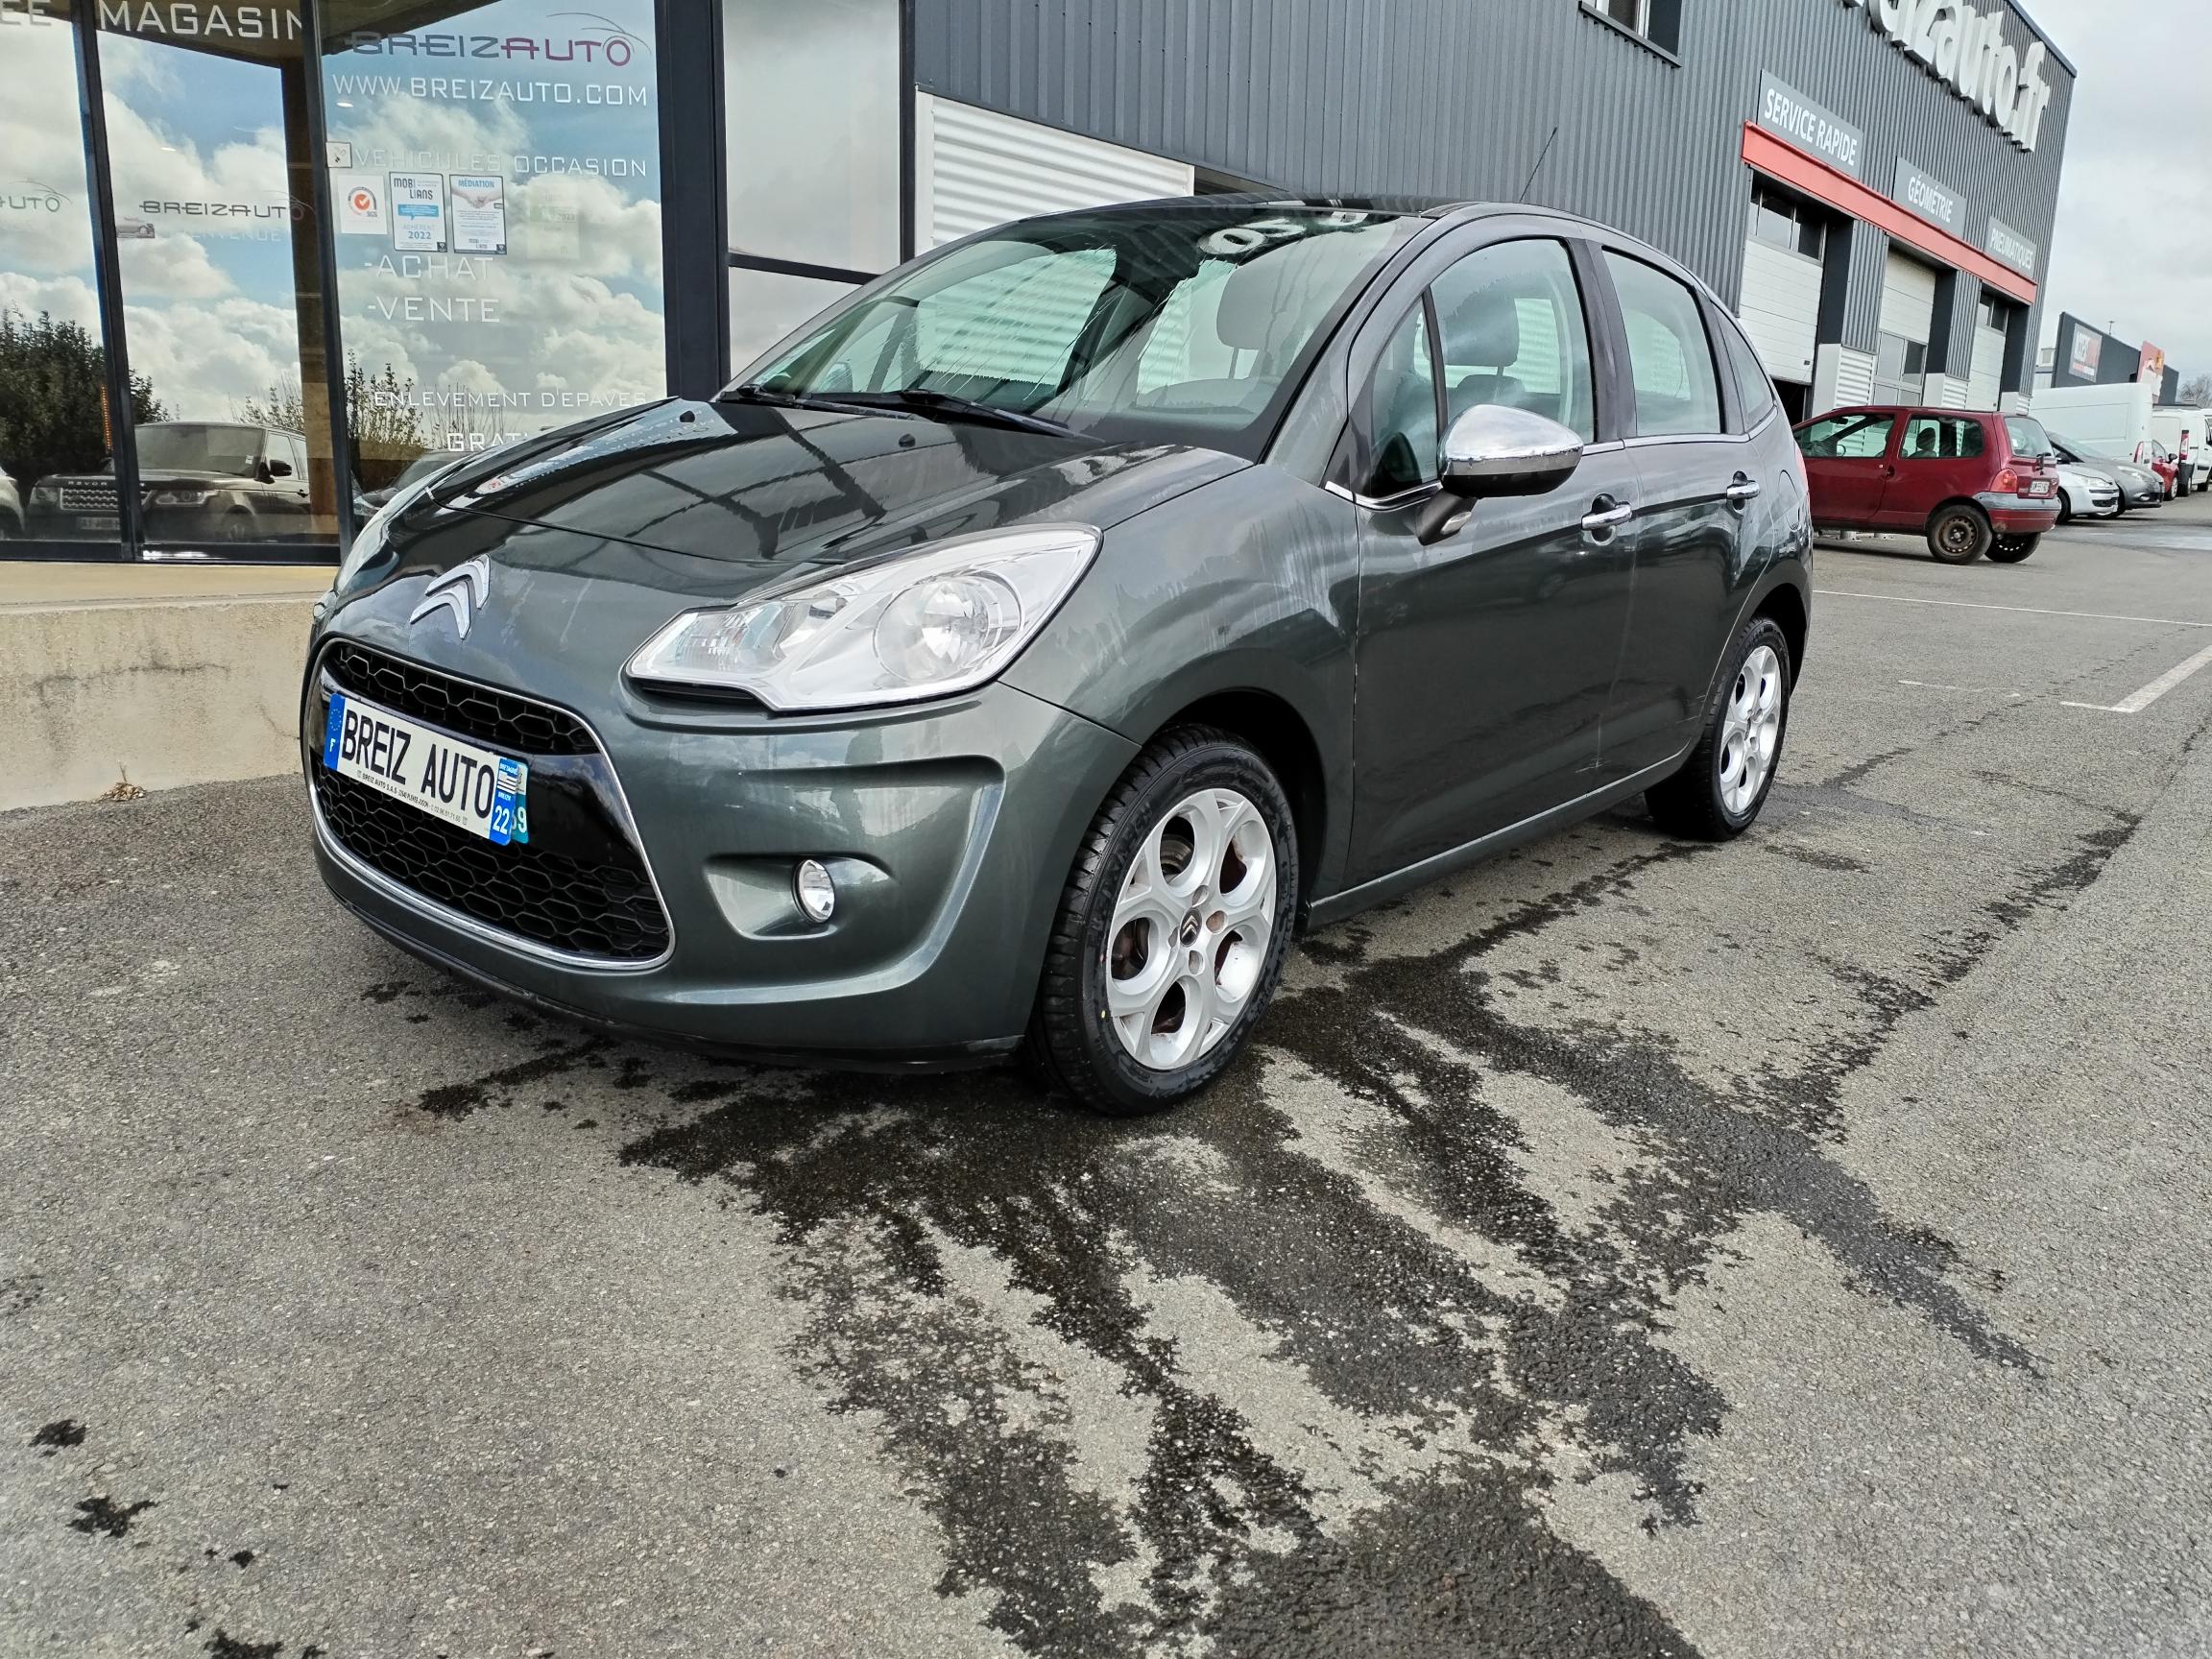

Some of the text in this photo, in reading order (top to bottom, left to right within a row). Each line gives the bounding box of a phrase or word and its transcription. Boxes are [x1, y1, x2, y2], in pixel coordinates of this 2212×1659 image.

[345, 30, 632, 67] BREIZAUTO
[332, 74, 648, 107] WWW.BREIZAUTO.COM
[1764, 87, 1859, 166] SERVICE RAPIDE
[354, 148, 647, 177] VEHICULES OCCASION
[139, 201, 304, 221] BREIZAUTO
[1908, 175, 1954, 223] GÉOMÉTRIE
[408, 231, 432, 240] 2022
[375, 391, 531, 407] ENLEVEMENT
[329, 738, 336, 752] F
[341, 709, 495, 819] BREIZ AUTO
[493, 805, 510, 835] 22
